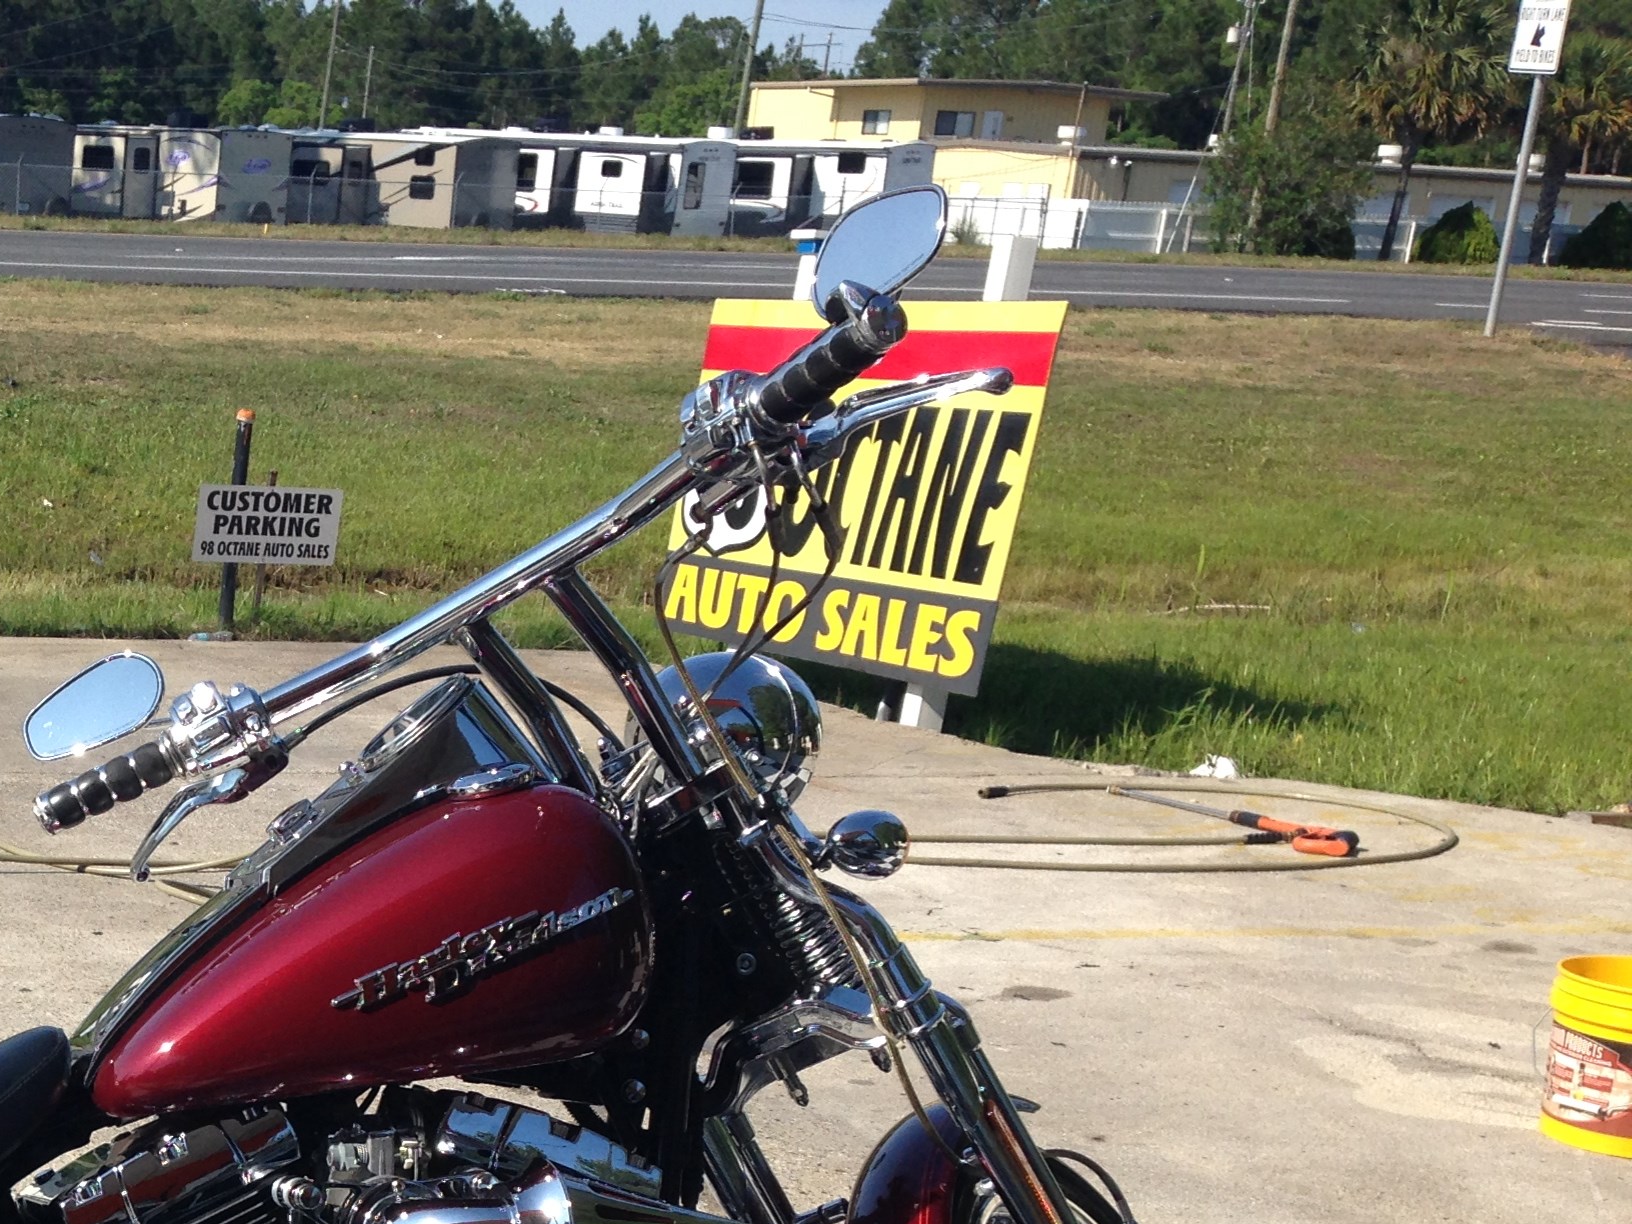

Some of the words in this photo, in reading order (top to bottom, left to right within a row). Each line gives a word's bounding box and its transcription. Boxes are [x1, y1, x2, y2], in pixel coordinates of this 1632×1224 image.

[206, 490, 333, 515] CUSTOMER
[212, 514, 321, 538] PARKING
[200, 541, 214, 556] 98
[217, 541, 261, 557] OCTANE
[263, 542, 295, 558] AUTO
[296, 543, 330, 559] SALES
[664, 563, 807, 642] AUTO
[815, 589, 981, 678] SALES
